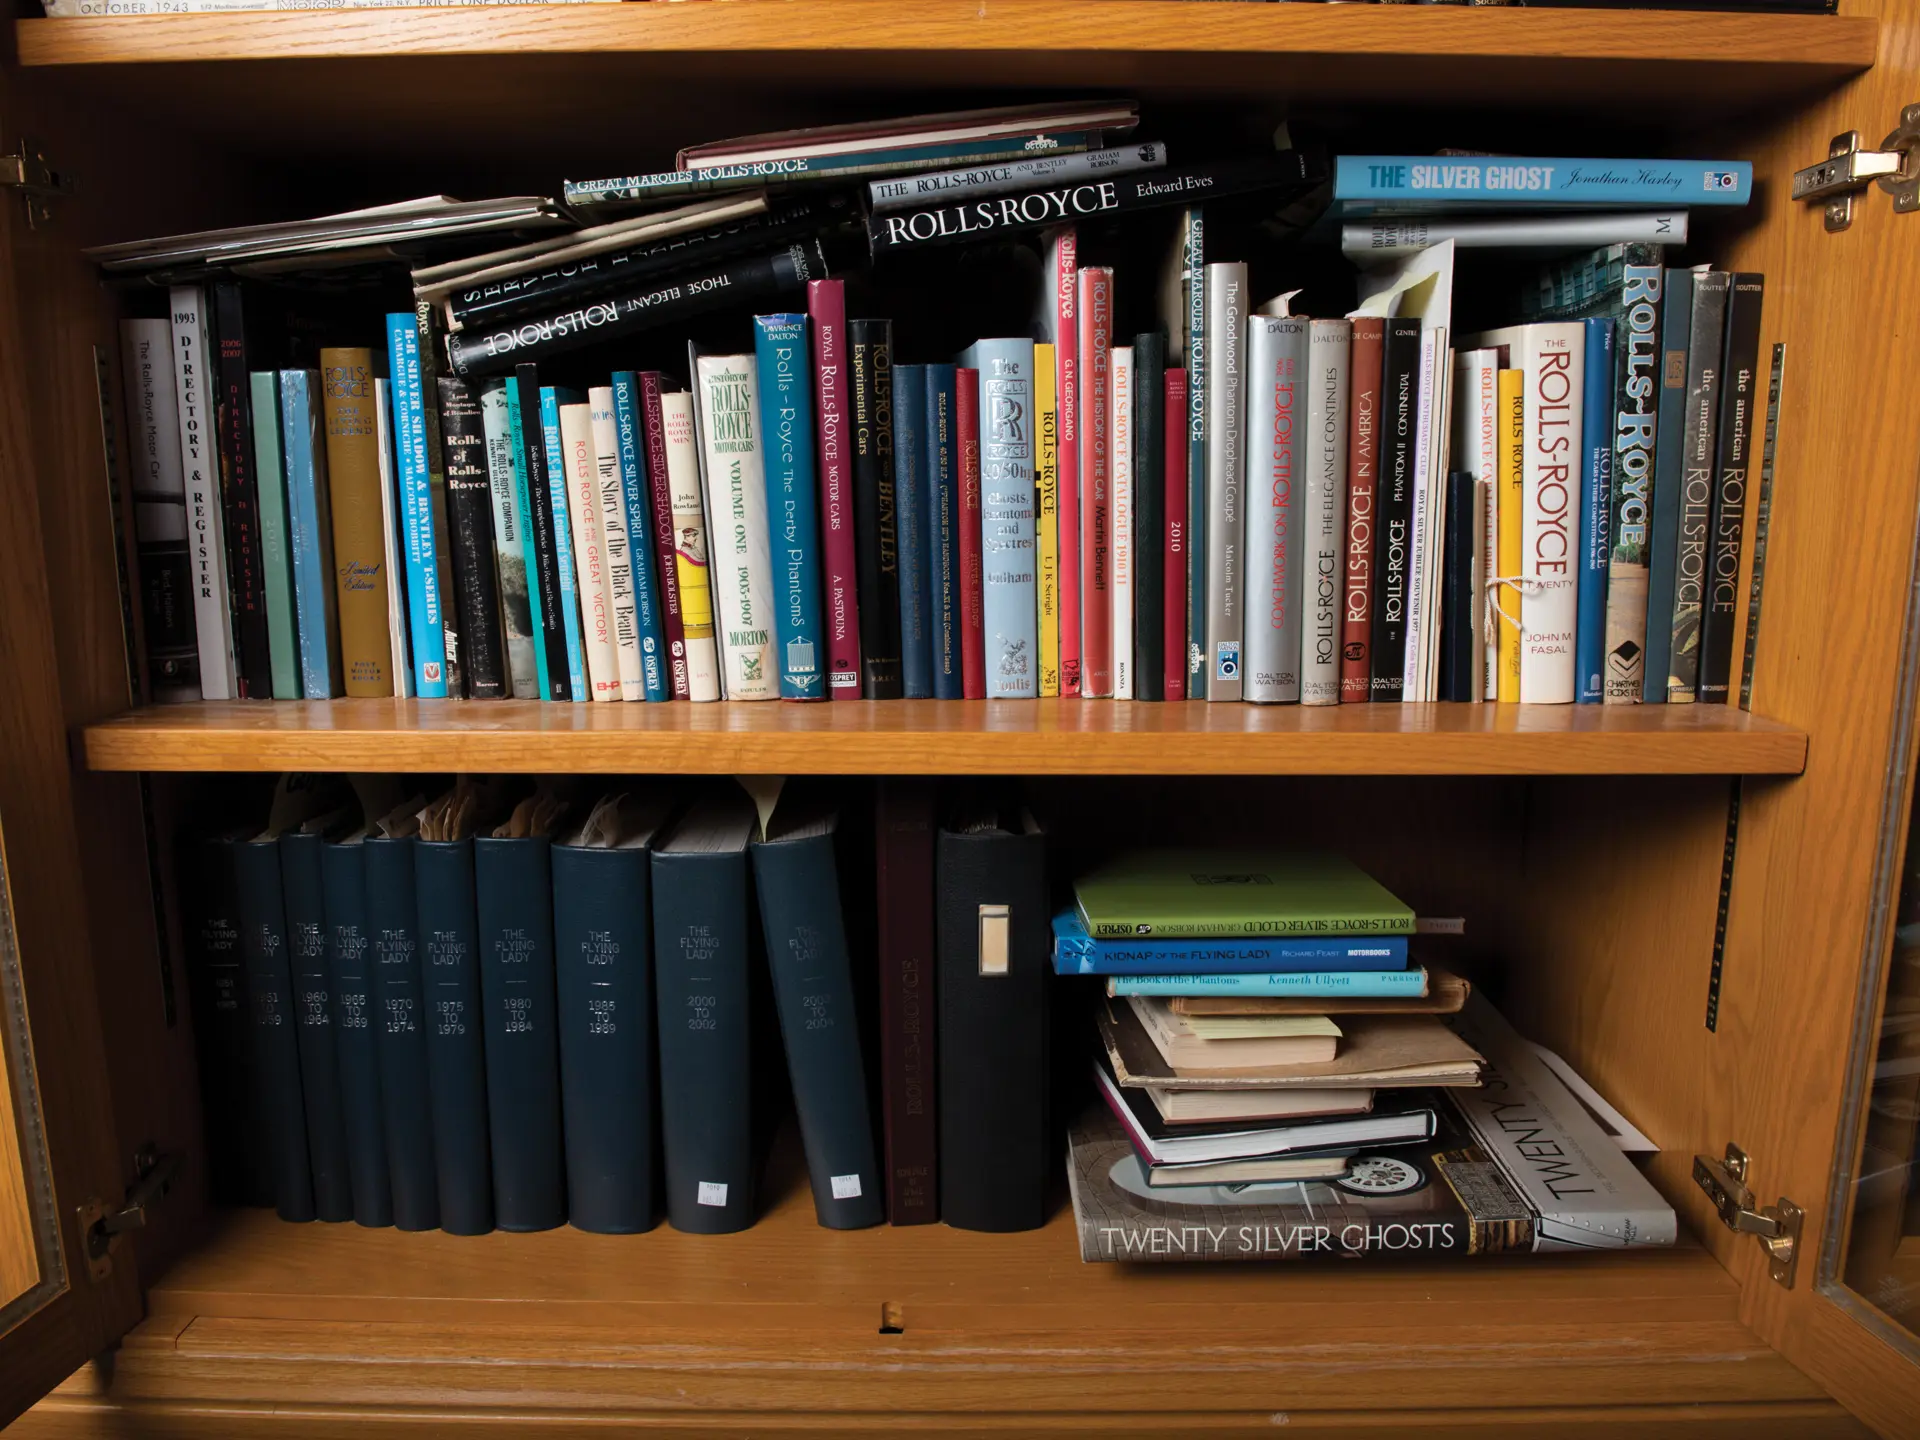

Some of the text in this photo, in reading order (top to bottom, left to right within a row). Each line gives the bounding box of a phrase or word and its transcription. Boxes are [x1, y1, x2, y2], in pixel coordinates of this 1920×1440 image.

[81, 2, 189, 14] OCTOBER 1943
[577, 158, 808, 192] GREAT MARQUES ROLLS-ROYCE
[1086, 152, 1120, 162] GRAHAM
[1090, 159, 1119, 168] ROBSON
[877, 159, 1067, 198] THE ROLLS-ROYCE BENTLEY
[1136, 177, 1183, 197] Edward
[1185, 175, 1213, 189] Eves
[1368, 166, 1683, 190] THE SILVER GHOST Jonathan Harley
[175, 314, 195, 324] 1993
[483, 273, 731, 356] THOSE ELEGANT ROLLS-ROYCE
[776, 348, 798, 391] Rolls
[1736, 369, 1750, 391] the
[140, 340, 159, 479] The Rolls-Royce Motor Car
[853, 344, 870, 455] Experimental Cars
[1065, 383, 1074, 440] GEORGANO
[1115, 366, 1129, 459] ROLLS-ROYCE
[447, 435, 482, 446] Rolls
[713, 412, 752, 440] ROYCE
[777, 407, 797, 463] Royce
[1093, 282, 1108, 590] ROLLS-ROYCE THE HISTORY OF THE CAR Martin Bennett
[1512, 396, 1523, 489] ROLLS ROYCE
[1732, 399, 1747, 461] american
[394, 329, 420, 563] CAMARGUE CORNICHE MALCOLM BOBBITT
[453, 449, 467, 462] of
[873, 344, 896, 577] ROLLS-ROYCE BENTLEY
[1222, 282, 1239, 616] The Goodwood Phantom Drophead Coupé Malcolm Tucker
[1536, 350, 1571, 577] ROLLS-ROYCE
[181, 336, 212, 599] DIRECTORY REGISTER
[404, 329, 438, 625] R-R SILVER SHADOW BENTLEY T-SERIES
[448, 465, 486, 477] Rolls-
[450, 480, 487, 490] Royce
[574, 441, 594, 523] ROLLS ROYCE
[782, 470, 794, 493] The
[821, 326, 845, 641] ROYAL ROLLS-ROYCE MOTOR CARS PASTOUNA
[496, 439, 514, 541] THE ROLLS-ROYCE COMPANION
[1115, 462, 1129, 542] CATALOGUE
[1272, 383, 1293, 628] COACHWORK ON ROLLS-ROYCE
[1348, 391, 1372, 622] ROLLS-ROYCE IN AMERICA
[1386, 372, 1409, 622] ROLLS-ROYCE PHANTOM CONTINENTAL
[1418, 490, 1426, 514] ROYAL
[783, 500, 798, 543] Derby
[1042, 411, 1054, 616] ROLLS-ROYCE Setright
[1316, 368, 1337, 665] ROLLS-ROYCE THE ELEGANCE CONTINUES
[1416, 517, 1424, 543] SILVER
[598, 453, 637, 649] The Story of the Black Beauty
[616, 382, 660, 691] ROLLS-ROYCE SILVER SPIRIT GRAHAM ROBSON OSPREY
[645, 377, 687, 695] ROLLS-ROYCE SILVER SHADOW JOHN BOLSTER OSPREY
[731, 460, 753, 626] VOLUME ONE 1903-1907
[1171, 521, 1181, 552] 2010
[1414, 546, 1422, 575] JUBILEE
[587, 546, 608, 644] GREAT VICTORY
[1413, 578, 1421, 615] SOUVENIR
[444, 630, 458, 663] Autocar
[729, 630, 768, 646] MORTON
[1526, 634, 1559, 642] JOHN
[1531, 645, 1568, 654] FASAL
[589, 931, 611, 942] THE
[1096, 919, 1409, 935] ROLLS-ROYCE SILVER CLOUD OSPREY
[582, 942, 620, 953] FLYING
[587, 954, 615, 965] LADY
[1104, 951, 1153, 961] KIDNAP
[1191, 950, 1235, 960] FLYING
[1238, 949, 1270, 960] LADY
[1190, 976, 1239, 984] Phantoms
[1268, 976, 1311, 985] Kenneth
[1315, 976, 1349, 987] Ullyett
[589, 1000, 616, 1011] 1985
[595, 1012, 609, 1022] TO
[589, 1022, 616, 1033] 1989
[1482, 1099, 1595, 1200] TWENTY
[1100, 1224, 1455, 1254] TWENTY SILVER GHOSTS
